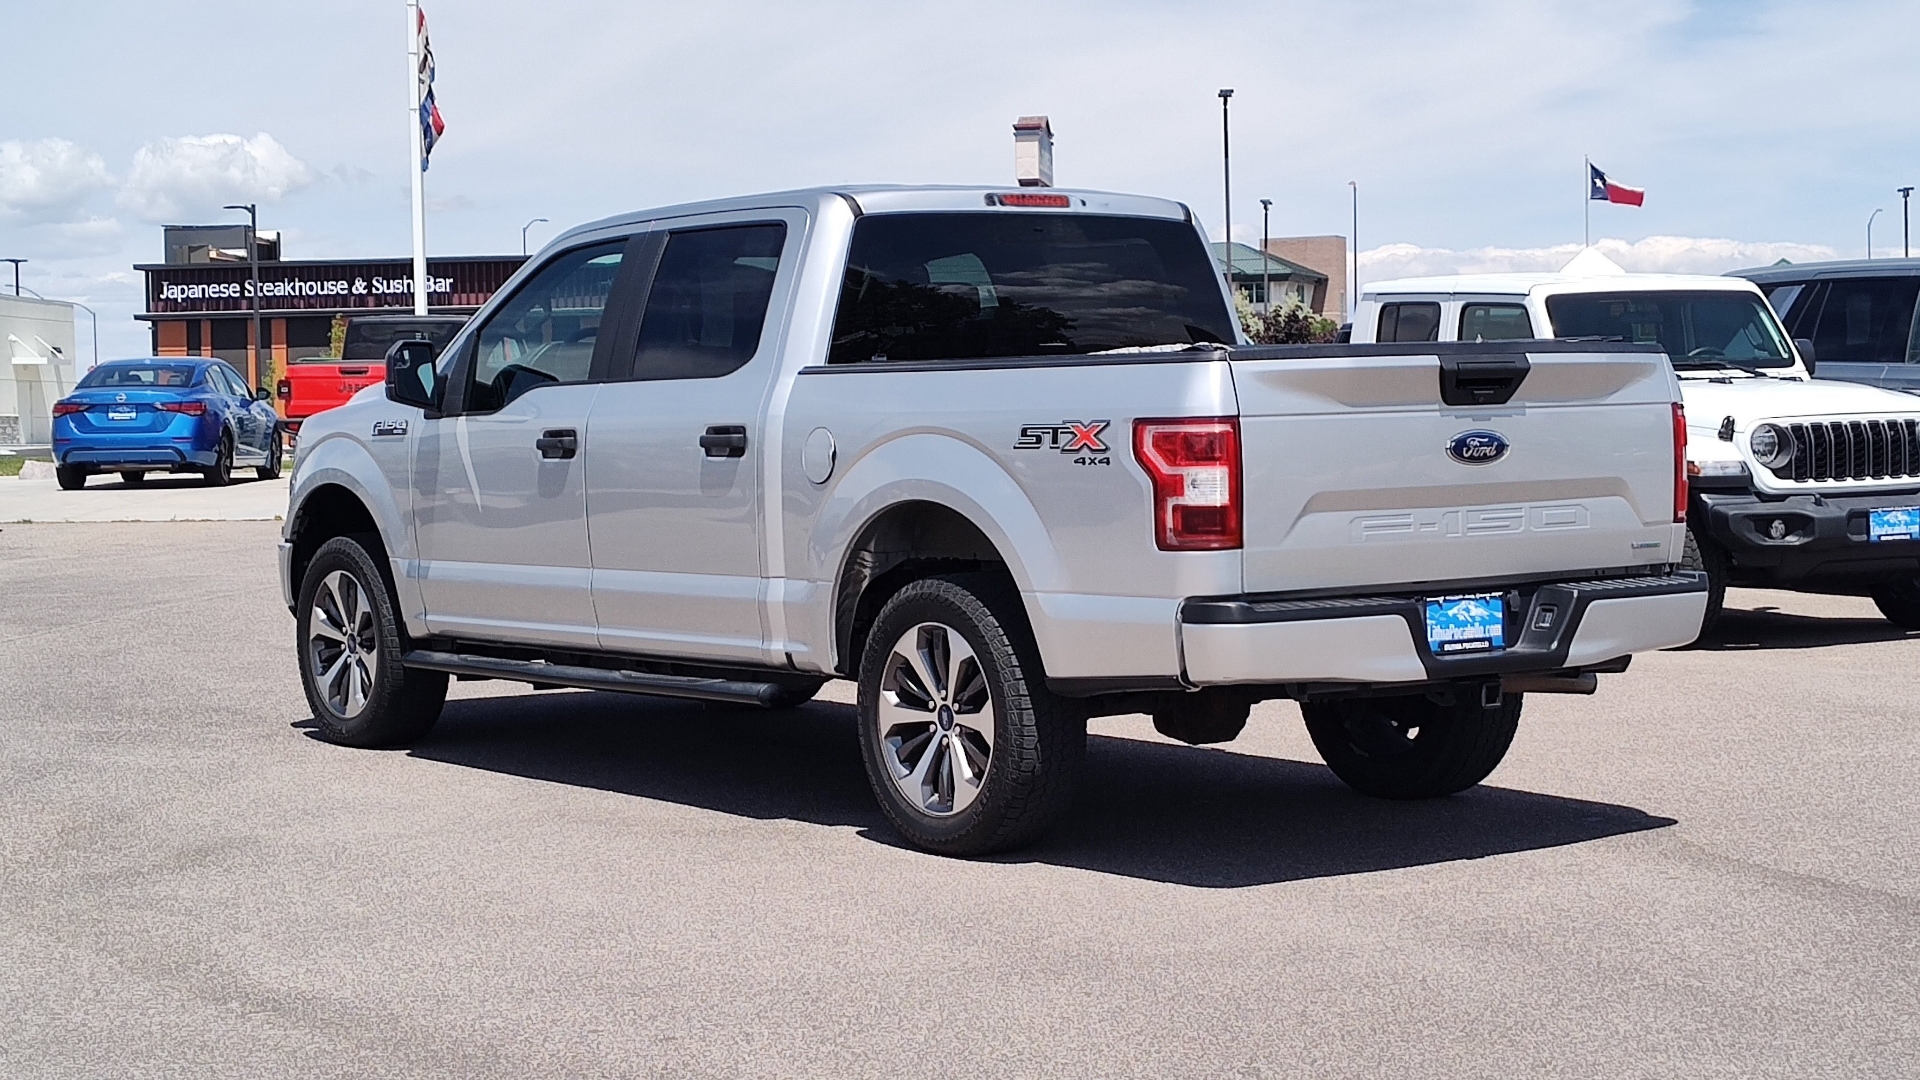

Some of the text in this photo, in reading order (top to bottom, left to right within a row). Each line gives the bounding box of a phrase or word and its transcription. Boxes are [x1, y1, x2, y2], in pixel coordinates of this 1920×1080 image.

[160, 275, 453, 303] Japanese Steakhouse & Sush Bar
[1013, 420, 1111, 454] STX
[1463, 437, 1498, 458] Ford
[1350, 503, 1590, 542] F-150
